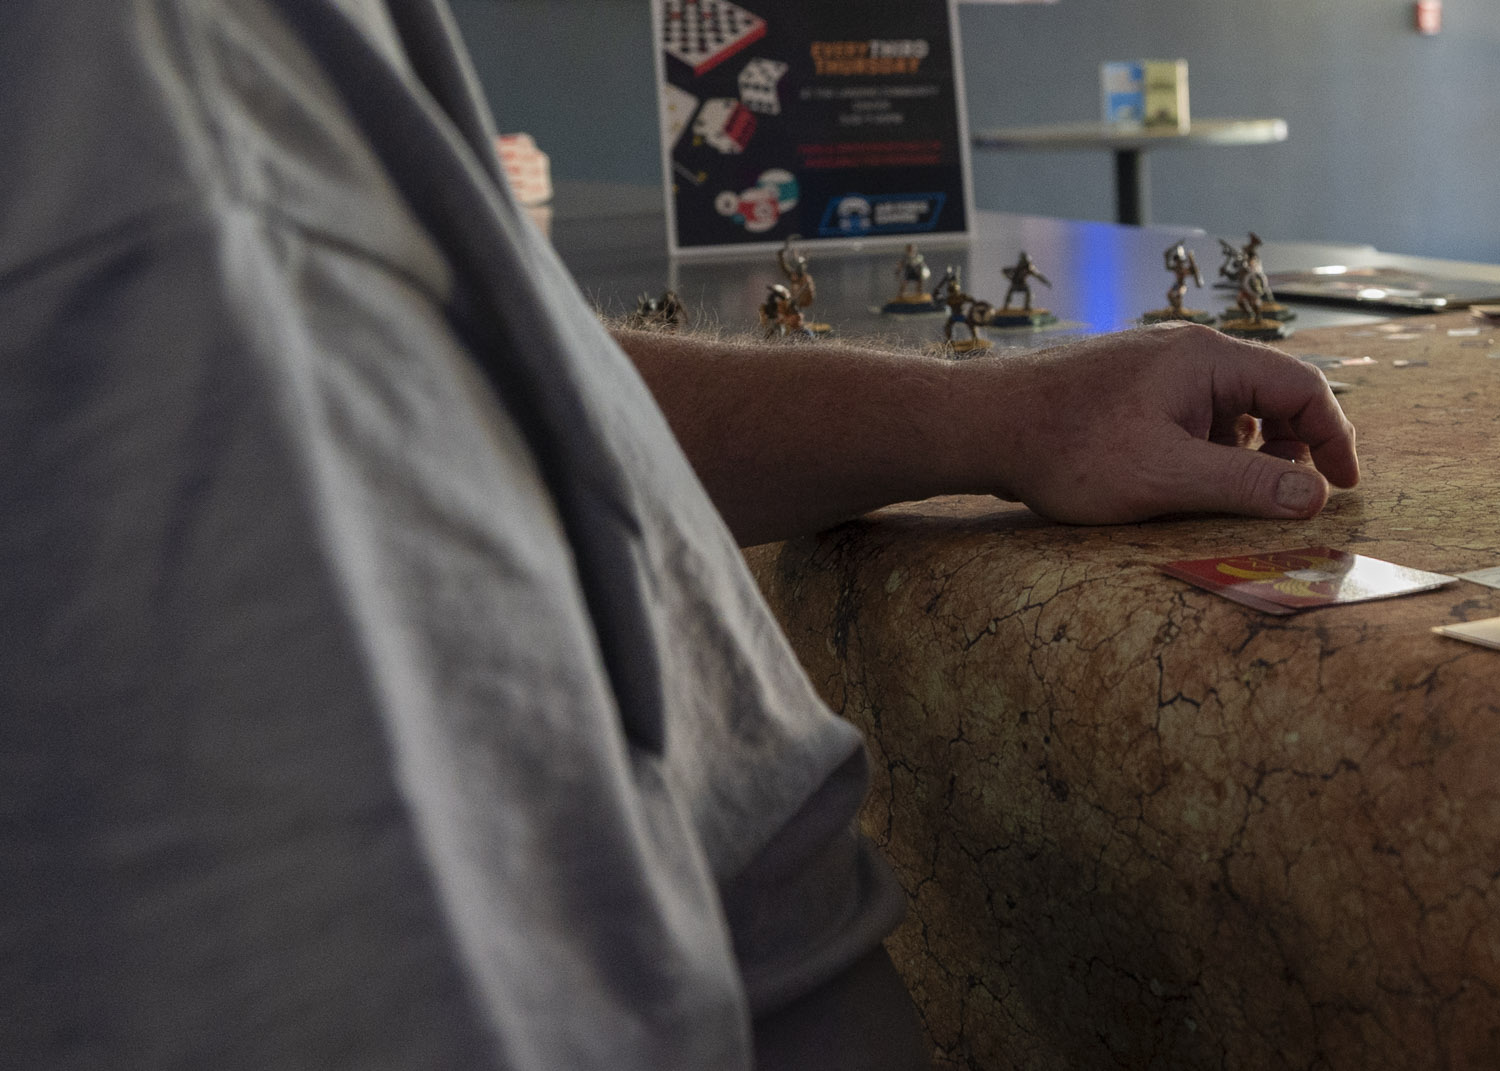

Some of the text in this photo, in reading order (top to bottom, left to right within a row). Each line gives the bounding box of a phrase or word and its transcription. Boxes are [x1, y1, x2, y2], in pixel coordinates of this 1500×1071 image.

[810, 39, 930, 59] EVERY THIRD
[814, 58, 920, 75] THURSDAY
